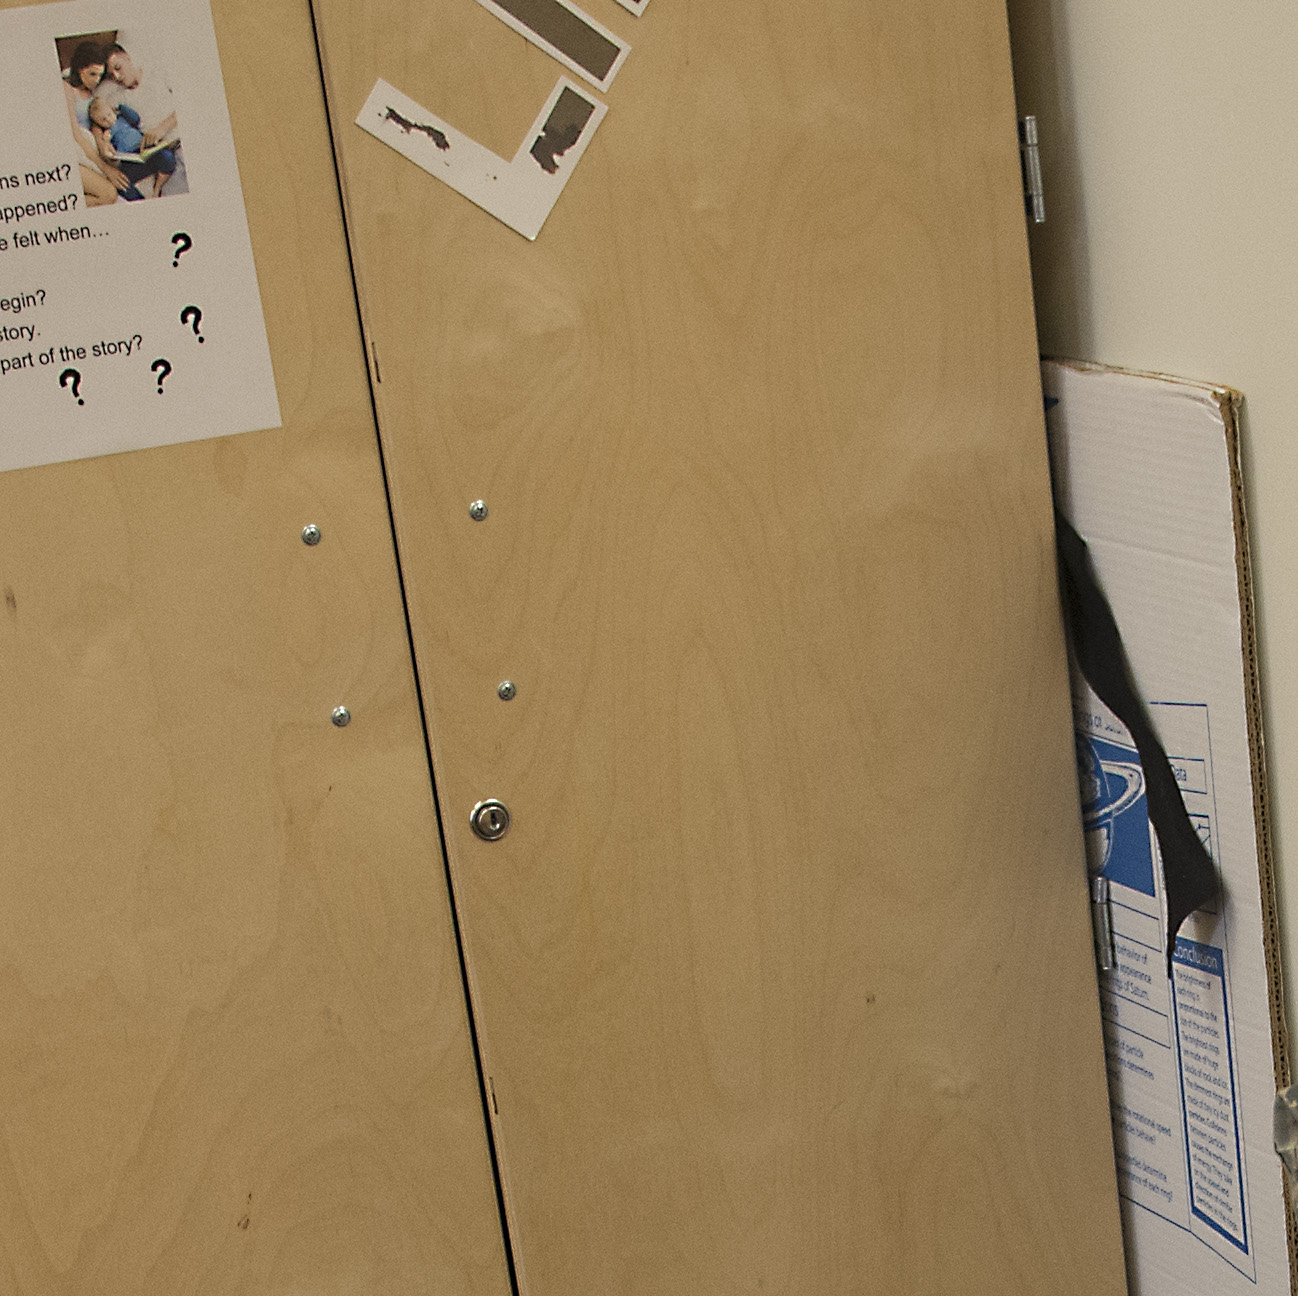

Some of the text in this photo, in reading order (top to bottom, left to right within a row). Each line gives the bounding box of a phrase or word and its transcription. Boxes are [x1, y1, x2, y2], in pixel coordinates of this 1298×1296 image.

[25, 164, 71, 186] next?
[13, 230, 41, 249] felt
[0, 289, 46, 314] egin?
[0, 334, 143, 375] part of the story?
